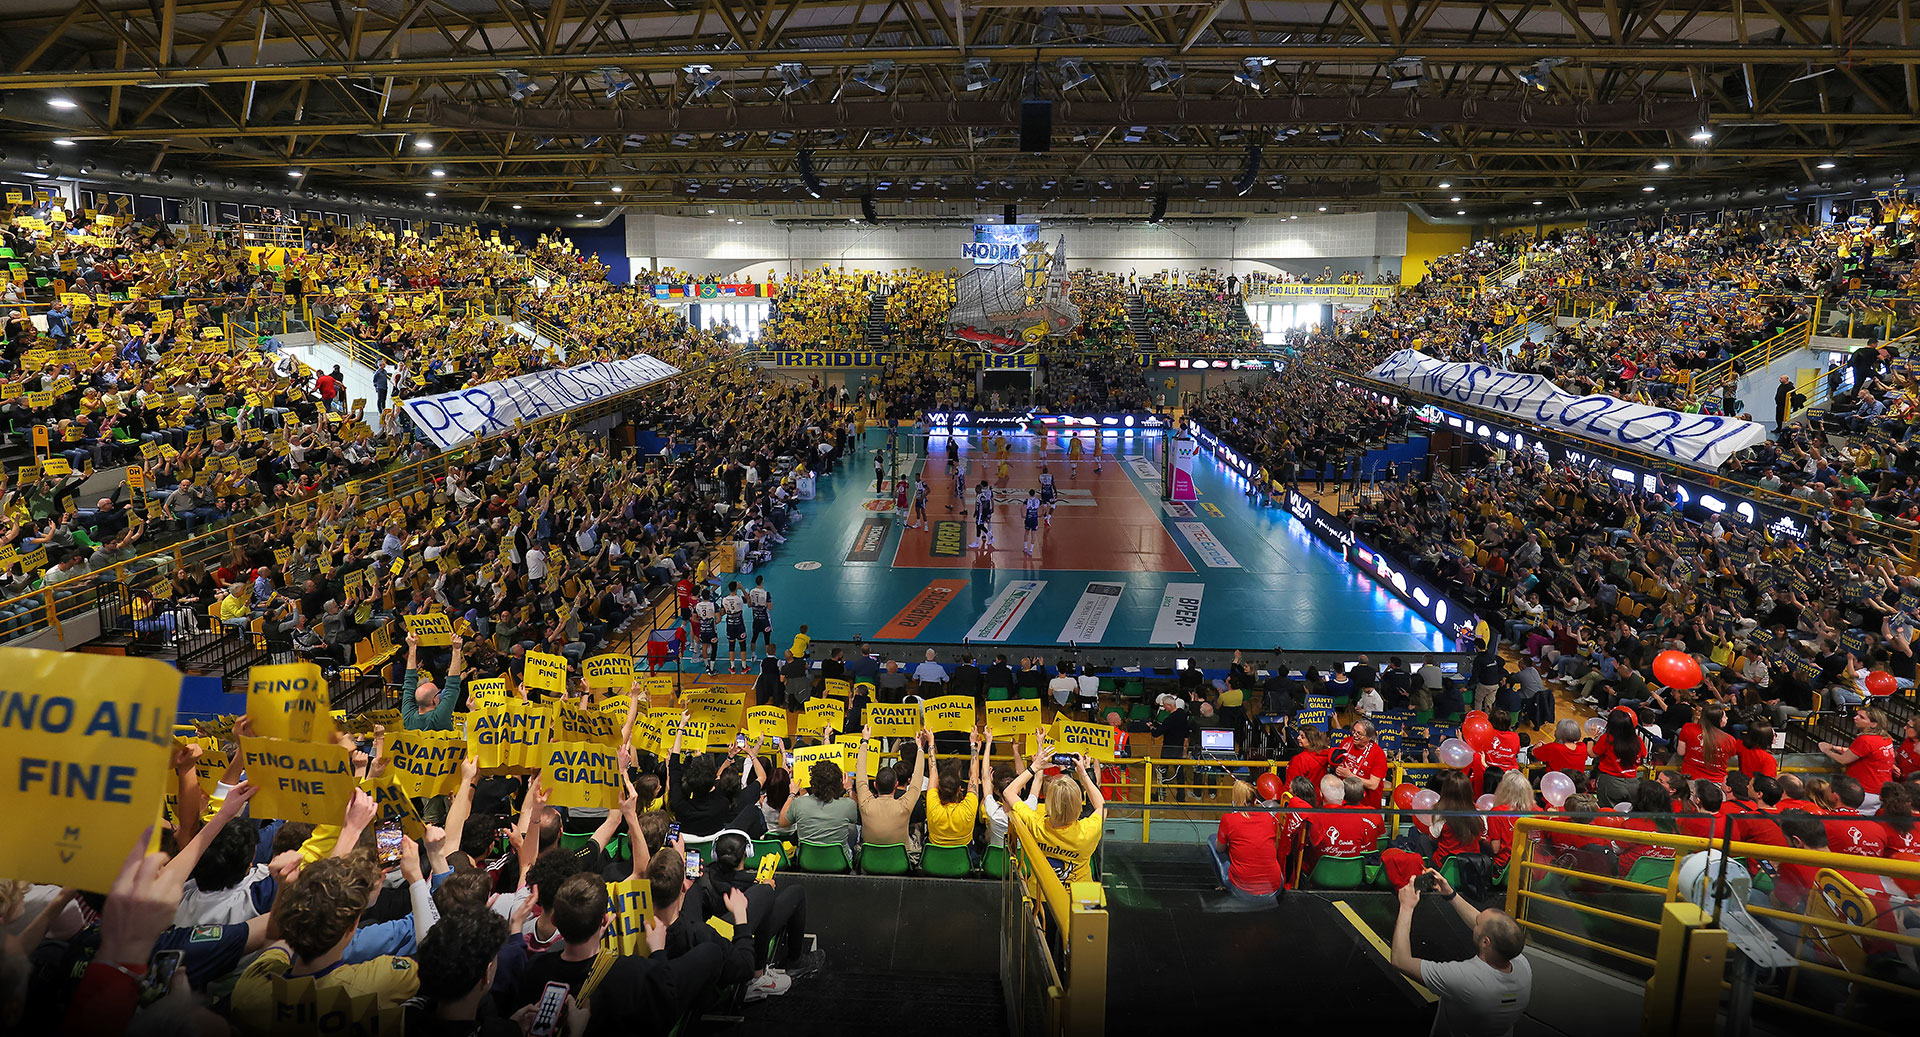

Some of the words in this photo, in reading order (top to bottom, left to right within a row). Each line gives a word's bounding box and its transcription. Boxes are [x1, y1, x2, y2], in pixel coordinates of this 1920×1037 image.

[962, 243, 1019, 259] MODNA
[1270, 286, 1283, 294] FINO
[1285, 286, 1299, 294] ALLA
[1300, 286, 1313, 295] FINE
[1315, 286, 1336, 295] AVANTI
[1358, 287, 1374, 296] GRAZIE
[410, 389, 506, 446] PER
[498, 378, 549, 421] LA
[536, 361, 638, 411] NOSTRA
[1421, 362, 1544, 413] NOSTRI
[1536, 390, 1752, 462] COLORI
[935, 521, 961, 555] CREDEM
[22, 549, 45, 562] AVANTI
[24, 554, 46, 567] GIALLI
[702, 609, 707, 617] 3
[415, 625, 452, 636] GIALLI
[527, 656, 547, 667] FINO
[586, 657, 631, 670] AVANTI
[538, 669, 558, 680] FINE
[589, 666, 631, 677] GIALLI
[253, 678, 309, 694] FINO
[472, 682, 505, 692] AVANT
[284, 699, 316, 714] FIN
[601, 700, 620, 712] FINO
[691, 697, 715, 705] FINO
[715, 698, 742, 706] ALLA
[925, 703, 947, 713] FINO
[949, 702, 973, 710] ALLA
[703, 705, 727, 713] FINE
[806, 703, 825, 713] FINO
[826, 703, 843, 713] ALLA
[871, 707, 917, 716] AVANTI
[988, 706, 1012, 714] FINO
[1013, 705, 1039, 713] ALLA
[559, 706, 613, 726] AVANTI
[748, 711, 767, 719] FINO
[767, 711, 786, 720] ALLA
[874, 716, 914, 725] GIALLI
[938, 711, 961, 719] FINE
[1002, 715, 1025, 723] FINE
[1298, 710, 1326, 719] AVANTI
[84, 700, 171, 748] ALL
[474, 711, 546, 732] AVANTI
[635, 720, 652, 732] FINO
[759, 718, 777, 726] FINE
[1300, 717, 1325, 725] GIALLI
[562, 720, 613, 737] GIALLI
[668, 728, 704, 739] GALLI
[1064, 725, 1111, 739] AVANTI
[478, 727, 539, 746] GIALLI
[1066, 735, 1109, 748] GIALLI
[390, 739, 467, 762] AVANTI
[549, 750, 619, 771] AVANTI
[795, 753, 817, 763] FINO
[818, 751, 842, 761] ALLA
[196, 758, 226, 769] LLA
[246, 751, 293, 770] FINO
[298, 758, 349, 776] ALLA
[393, 755, 457, 777] GIALLI
[19, 756, 137, 804] FINE
[553, 767, 619, 787] GIALLI
[278, 777, 325, 795] FINE
